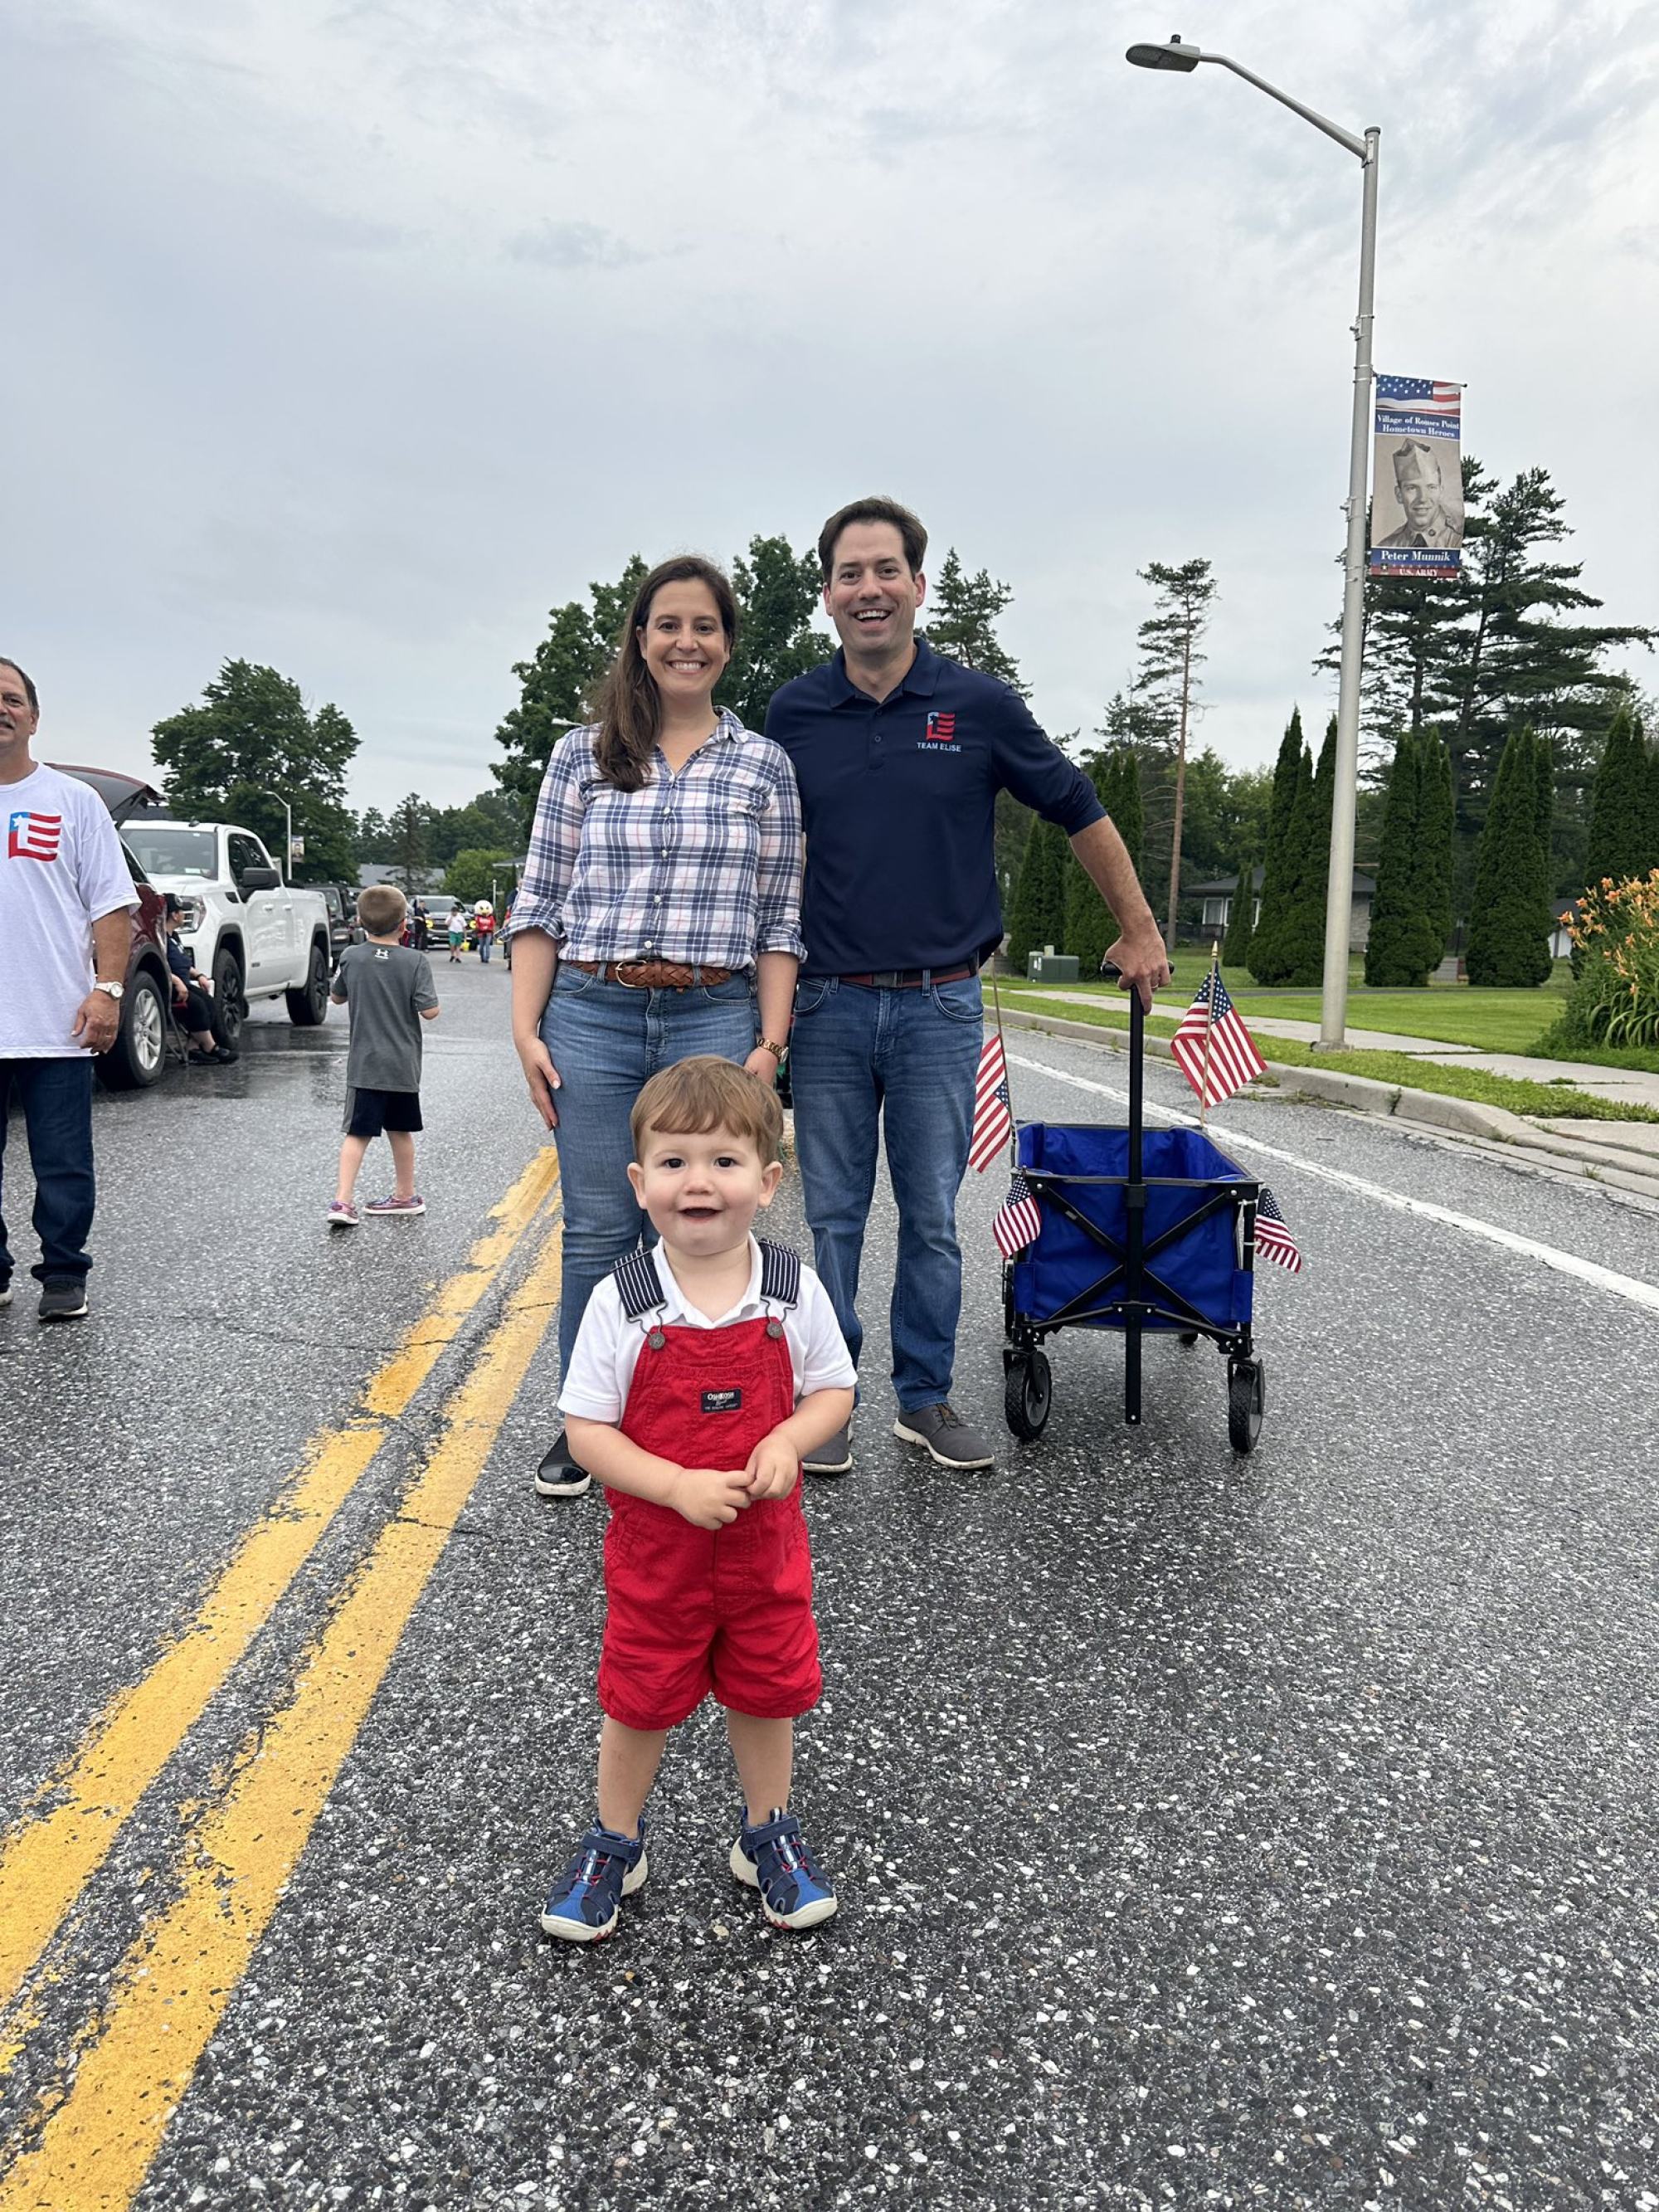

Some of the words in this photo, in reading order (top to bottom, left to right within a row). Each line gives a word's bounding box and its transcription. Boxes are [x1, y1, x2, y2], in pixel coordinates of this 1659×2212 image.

[1378, 414, 1403, 424] Village
[1442, 420, 1459, 429] Point
[1383, 424, 1426, 434] Hometown
[1429, 427, 1455, 437] Heroes
[1381, 550, 1408, 561] Peter
[940, 743, 961, 753] ELISE
